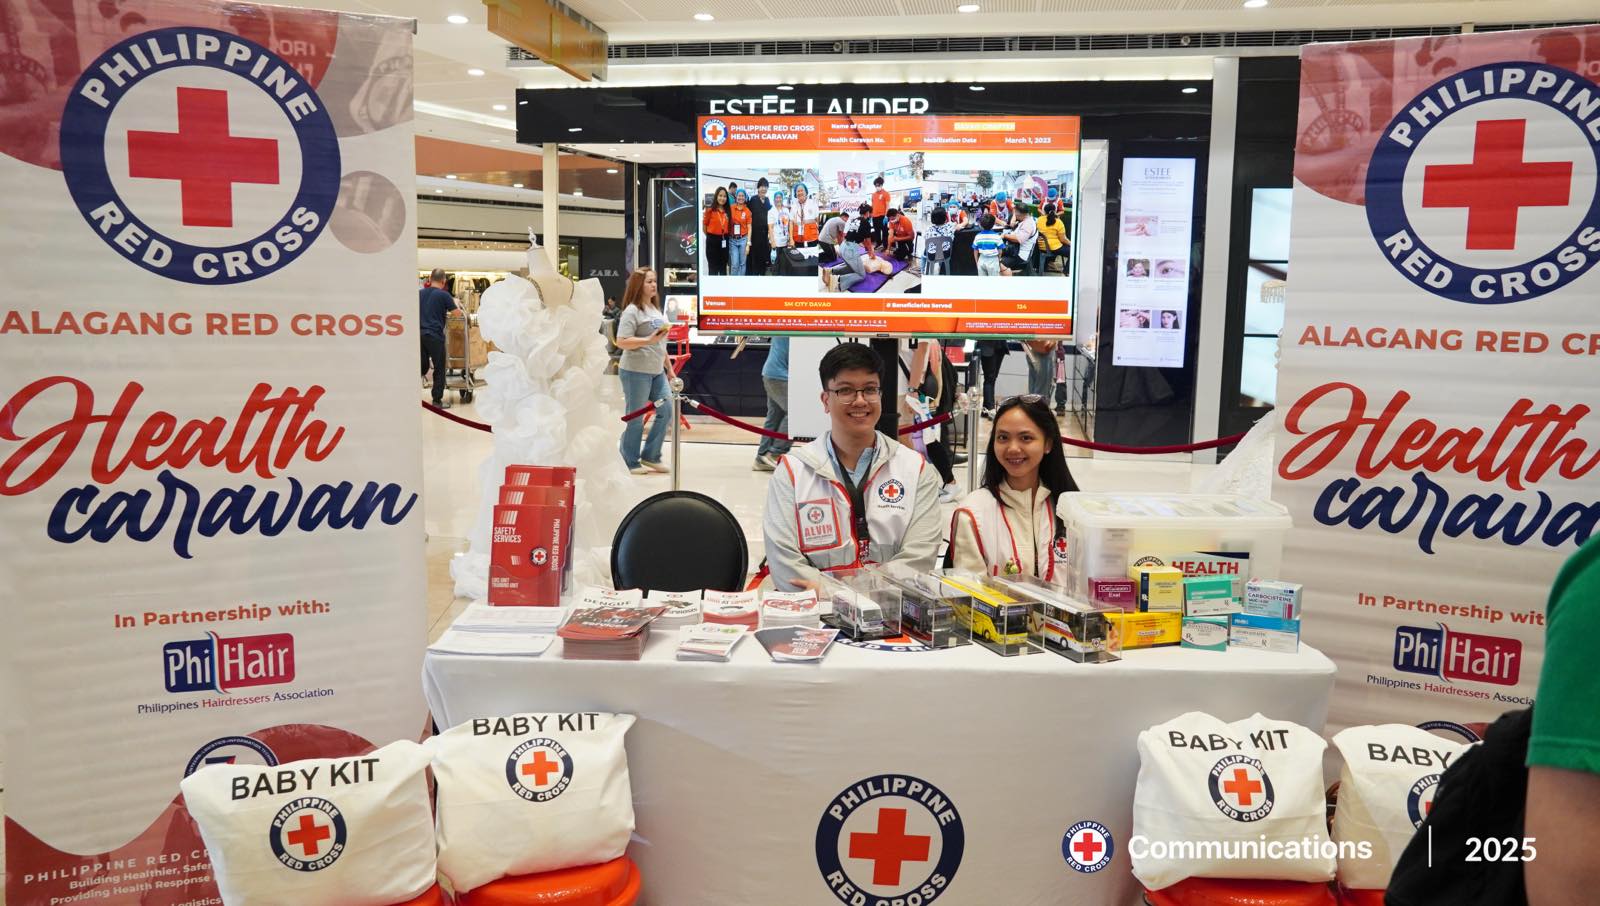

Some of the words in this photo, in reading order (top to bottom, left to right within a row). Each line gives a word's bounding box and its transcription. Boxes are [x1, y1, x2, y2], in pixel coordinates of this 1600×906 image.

[80, 33, 317, 121] PHILIPPINE
[730, 133, 760, 141] HEALTH
[761, 133, 799, 141] CARAVAN
[857, 123, 883, 131] Chapter
[89, 200, 173, 269] RED
[193, 206, 320, 279] CROSS
[589, 269, 620, 277] ZARA
[1383, 229, 1453, 290] RED
[1470, 226, 1600, 299] CROSS
[0, 310, 193, 336] ALAGANG
[205, 312, 279, 336] RED
[289, 313, 405, 337] CROSS
[1298, 325, 1462, 351] ALAGANG
[1475, 330, 1549, 354] RED
[0, 375, 346, 496] Health
[1278, 381, 1600, 491] Health
[46, 469, 419, 560] caravan
[1312, 471, 1600, 554] carava
[493, 526, 517, 535] SAFETY
[493, 534, 522, 544] SERVICES
[552, 518, 561, 545] PHILIPPINE
[804, 524, 833, 537] ALVIN
[1172, 561, 1240, 575] HEALTH
[583, 598, 631, 607] DENGUE
[1247, 592, 1293, 603] CARBOCISTEINE
[1358, 592, 1375, 607] In
[1382, 595, 1503, 623] Partnership
[1509, 609, 1545, 626] wit
[114, 614, 136, 629] In
[143, 604, 272, 628] Partnership
[278, 600, 331, 619] with:
[137, 700, 199, 715] Philippines
[202, 693, 271, 709] Hairdressers
[272, 687, 335, 702] Association
[1366, 674, 1421, 691] Philippines
[1424, 682, 1490, 701] Hairdressers
[1493, 691, 1535, 707] Associa
[473, 715, 549, 737] BABY
[558, 713, 599, 732] KIT
[510, 738, 567, 761] PHILIPPINE
[1168, 730, 1244, 751] BABY
[1249, 729, 1289, 751] KIT
[1367, 743, 1453, 770] BABY
[231, 766, 320, 801] BABY
[330, 758, 380, 787] KIT
[511, 782, 534, 801] RED
[536, 775, 570, 802] CROSS
[273, 798, 340, 829] PHILIPPINE
[829, 777, 957, 827] PHILIPPINE
[1216, 799, 1239, 821] RED
[1242, 799, 1274, 822] CROSS
[24, 858, 137, 884] PHILIPPINE
[146, 852, 182, 866] RED
[279, 852, 304, 871] RED
[307, 842, 344, 871] CROSS
[50, 888, 111, 906] Providing
[113, 883, 153, 896] Health
[155, 875, 211, 890] Response
[69, 874, 121, 891] Building
[123, 868, 181, 883] Healthier,
[827, 870, 867, 906] RED
